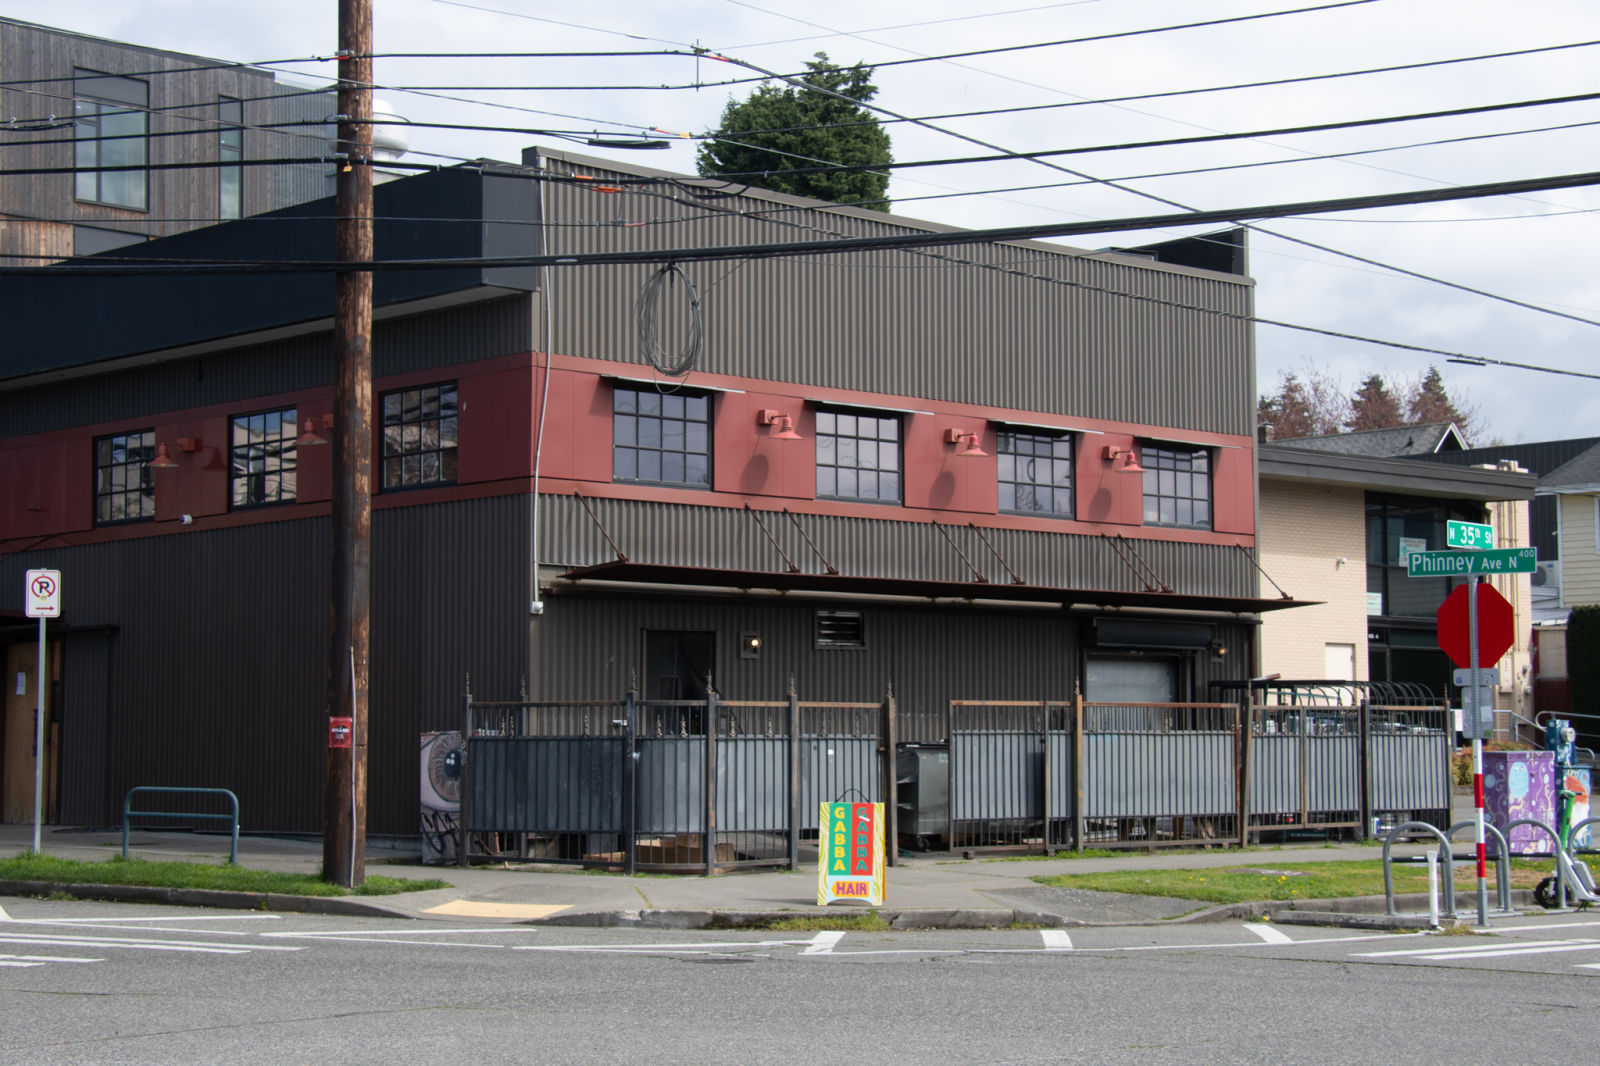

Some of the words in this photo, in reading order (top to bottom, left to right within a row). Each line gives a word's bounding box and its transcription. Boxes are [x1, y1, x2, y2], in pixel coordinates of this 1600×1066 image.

[1449, 527, 1455, 540] N
[1460, 525, 1481, 545] 35th
[1484, 531, 1492, 545] St
[1411, 553, 1475, 574] Phinney
[1481, 557, 1502, 570] Ave
[1508, 556, 1517, 569] N
[1519, 550, 1535, 558] 400
[833, 806, 846, 872] GABBA
[856, 807, 868, 872] GABBA
[836, 882, 867, 896] HAIR
